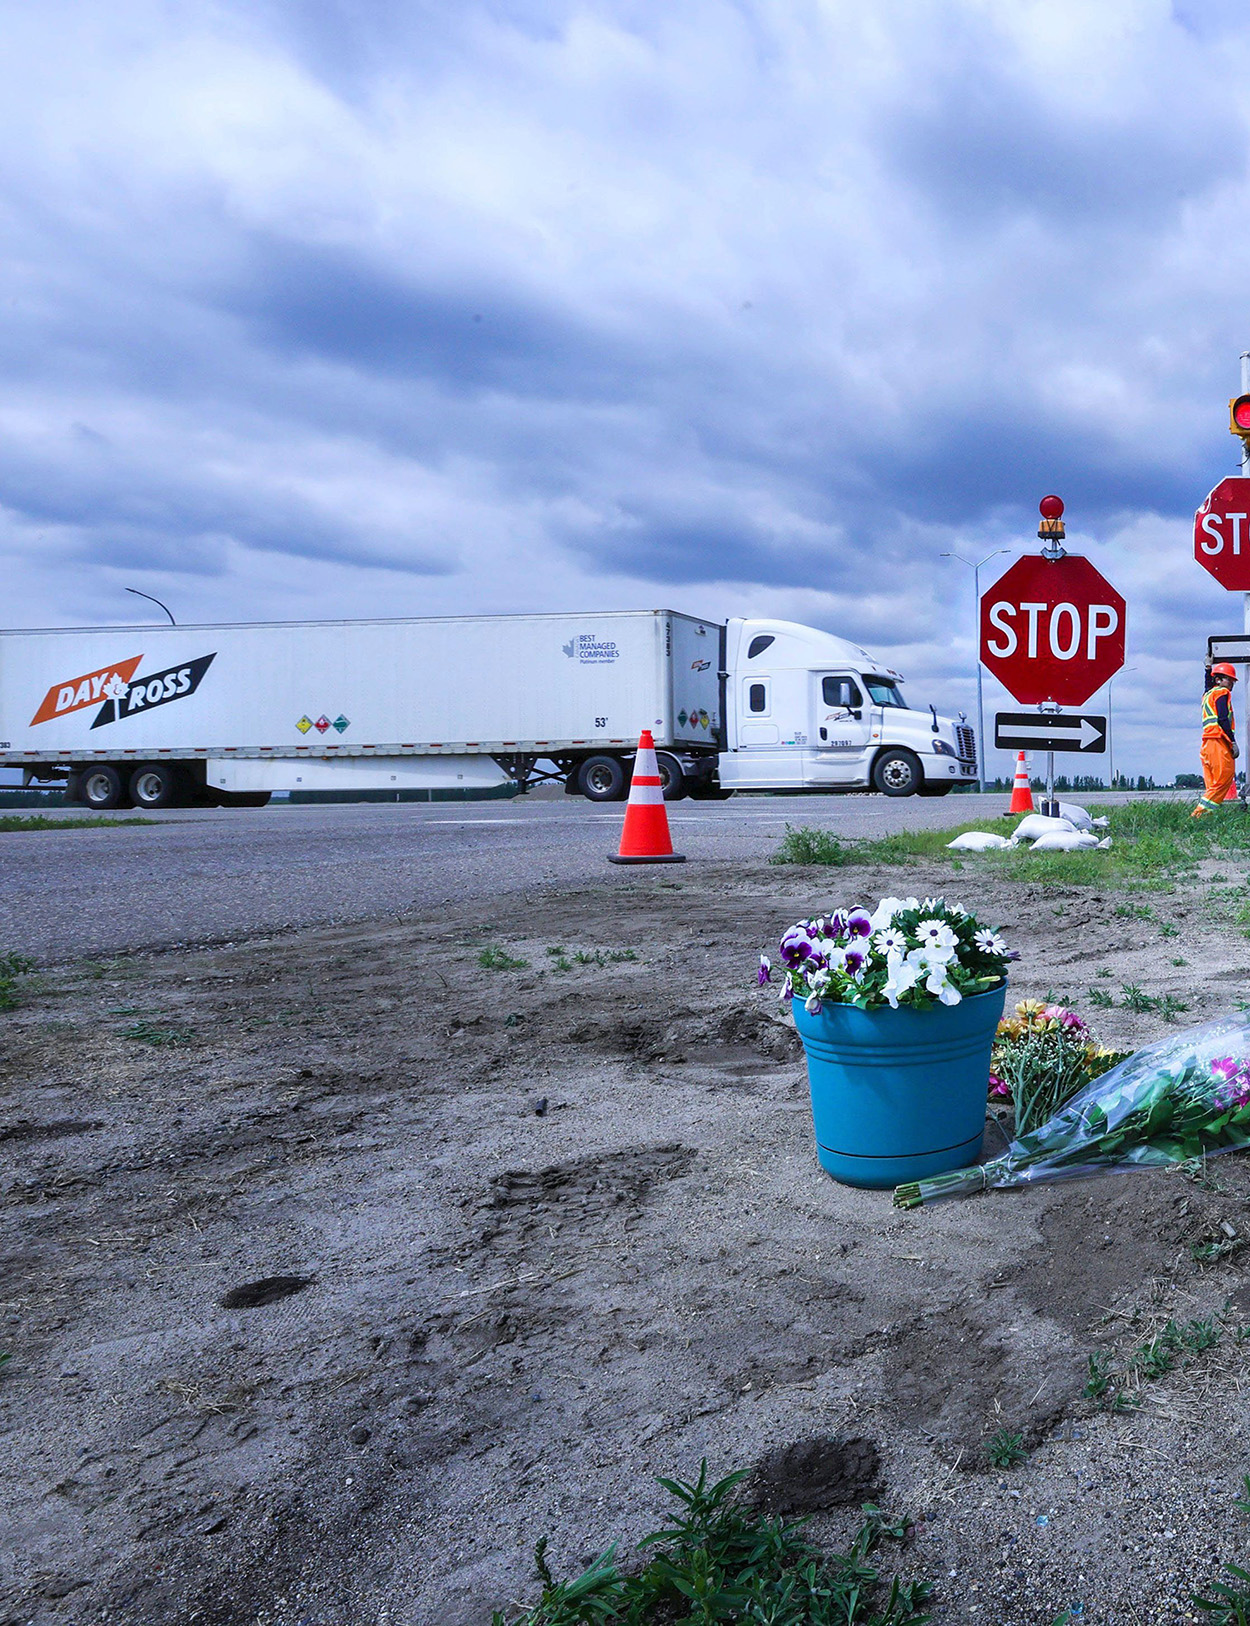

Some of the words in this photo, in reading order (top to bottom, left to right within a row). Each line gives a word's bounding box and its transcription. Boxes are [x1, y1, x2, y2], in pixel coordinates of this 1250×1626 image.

[987, 601, 1119, 661] STOP
[580, 634, 596, 642] BEST
[580, 642, 616, 650] MANAGED
[580, 650, 620, 658] COMPANIES
[55, 672, 109, 713] DAY
[128, 668, 192, 711] ROSS
